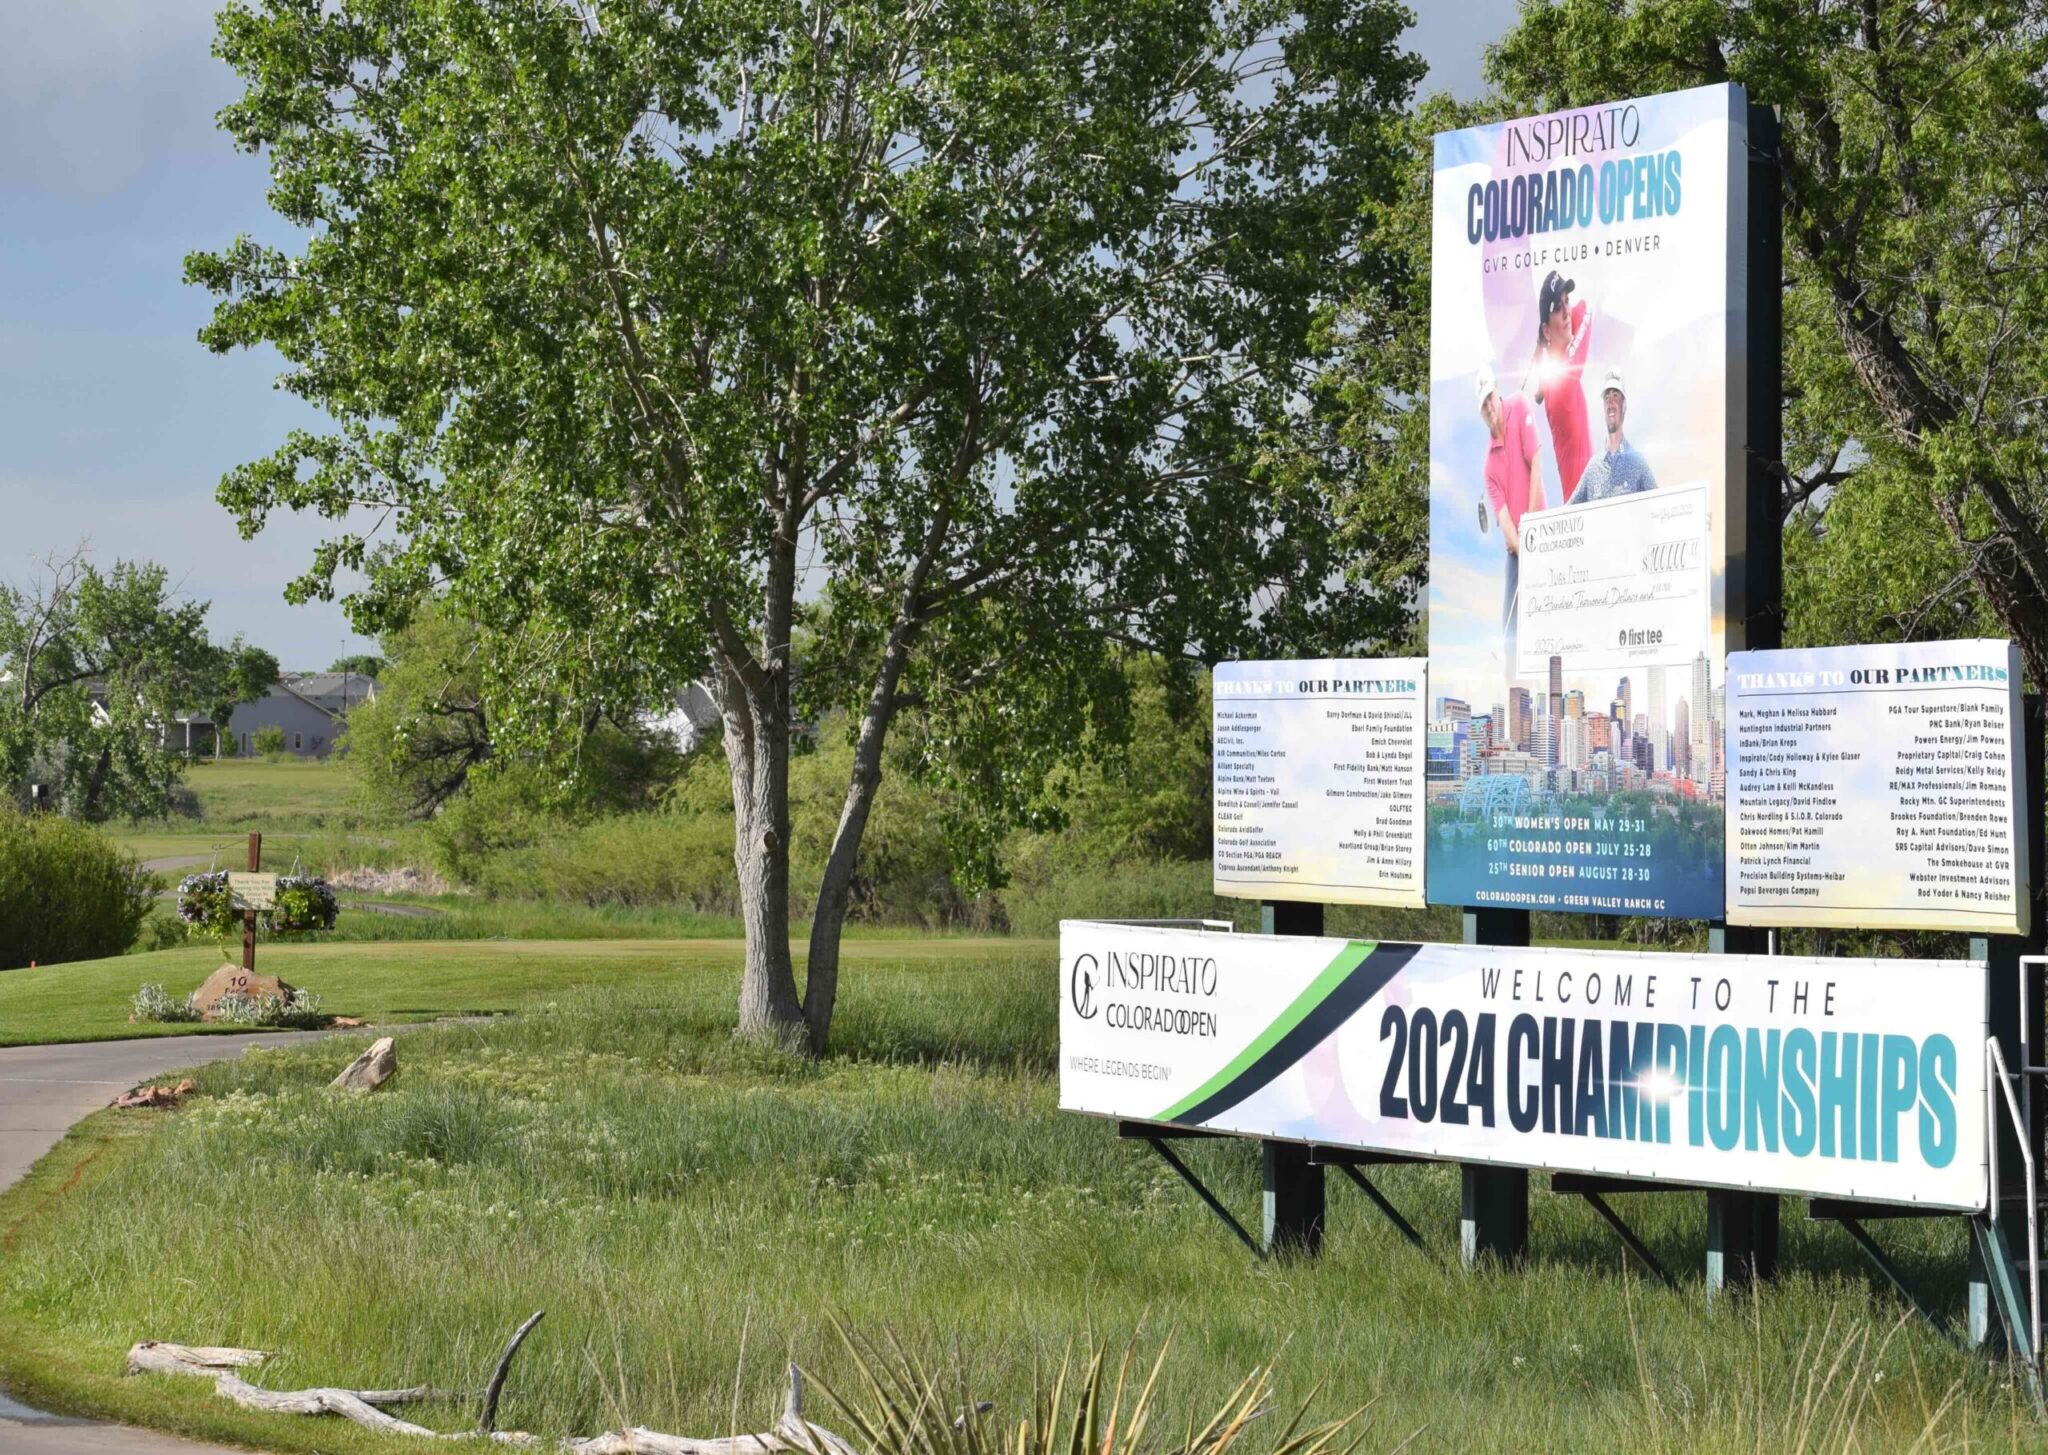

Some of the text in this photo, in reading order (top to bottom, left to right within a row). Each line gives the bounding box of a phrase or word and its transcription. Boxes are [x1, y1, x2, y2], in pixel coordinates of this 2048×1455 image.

[1507, 105, 1639, 167] INSPIRATO
[1467, 151, 1681, 245] COLORADO OPENS
[1484, 235, 1660, 274] GVR GOLF CLUB DENVER
[1540, 516, 1584, 536] INSPIRATO
[1629, 629, 1662, 645] first tee
[1738, 665, 2007, 688] THANKS TO OUR PARTNERS
[1215, 680, 1416, 694] THANKS TO OUR PARTNERS
[1757, 710, 1779, 719] Meghan
[1811, 708, 1836, 716] Hubbard
[1889, 706, 1901, 714] PGA
[1921, 703, 1978, 714] Superstore/Blank
[1981, 704, 2003, 715] Family
[1740, 725, 1772, 734] Huntington
[1915, 735, 2005, 745] Powers Energy/Jim Powers
[1898, 750, 2005, 760] Proprietary Capital/Craig Cohen
[1740, 769, 1757, 778] Sandy
[1783, 768, 1796, 777] King
[1900, 797, 2005, 807] Rocky Mtn. GC Superintendents
[1493, 816, 1645, 832] 30TH WOMEN'S OPEN MAY 29-31
[1897, 828, 2006, 838] Roy A. Hunt Foundation/Ed Hunt
[1488, 839, 1651, 856] 60TH COLORADO OPEN JULY 25-28
[1783, 857, 1810, 865] Financial
[1942, 858, 1982, 868] Smokehouse
[1986, 860, 1992, 868] at
[1995, 861, 2009, 870] GVR
[1489, 862, 1650, 881] 25TH SENIOR OPEN AUGUST 28-30
[1910, 873, 2009, 885] Webster Investment Advisors
[1476, 891, 1665, 909] COLORADOOPEN.COM GREEN VALLEY RANCH GC
[231, 976, 247, 986] 10
[1107, 951, 1217, 996] INSPIRATO
[1481, 968, 1838, 1016] WELCOME TO THE
[1070, 1056, 1098, 1073] WHERE
[1101, 1058, 1140, 1079] LEGENDS
[1379, 1004, 1958, 1169] 2024 CHAMPIONSHIPS
